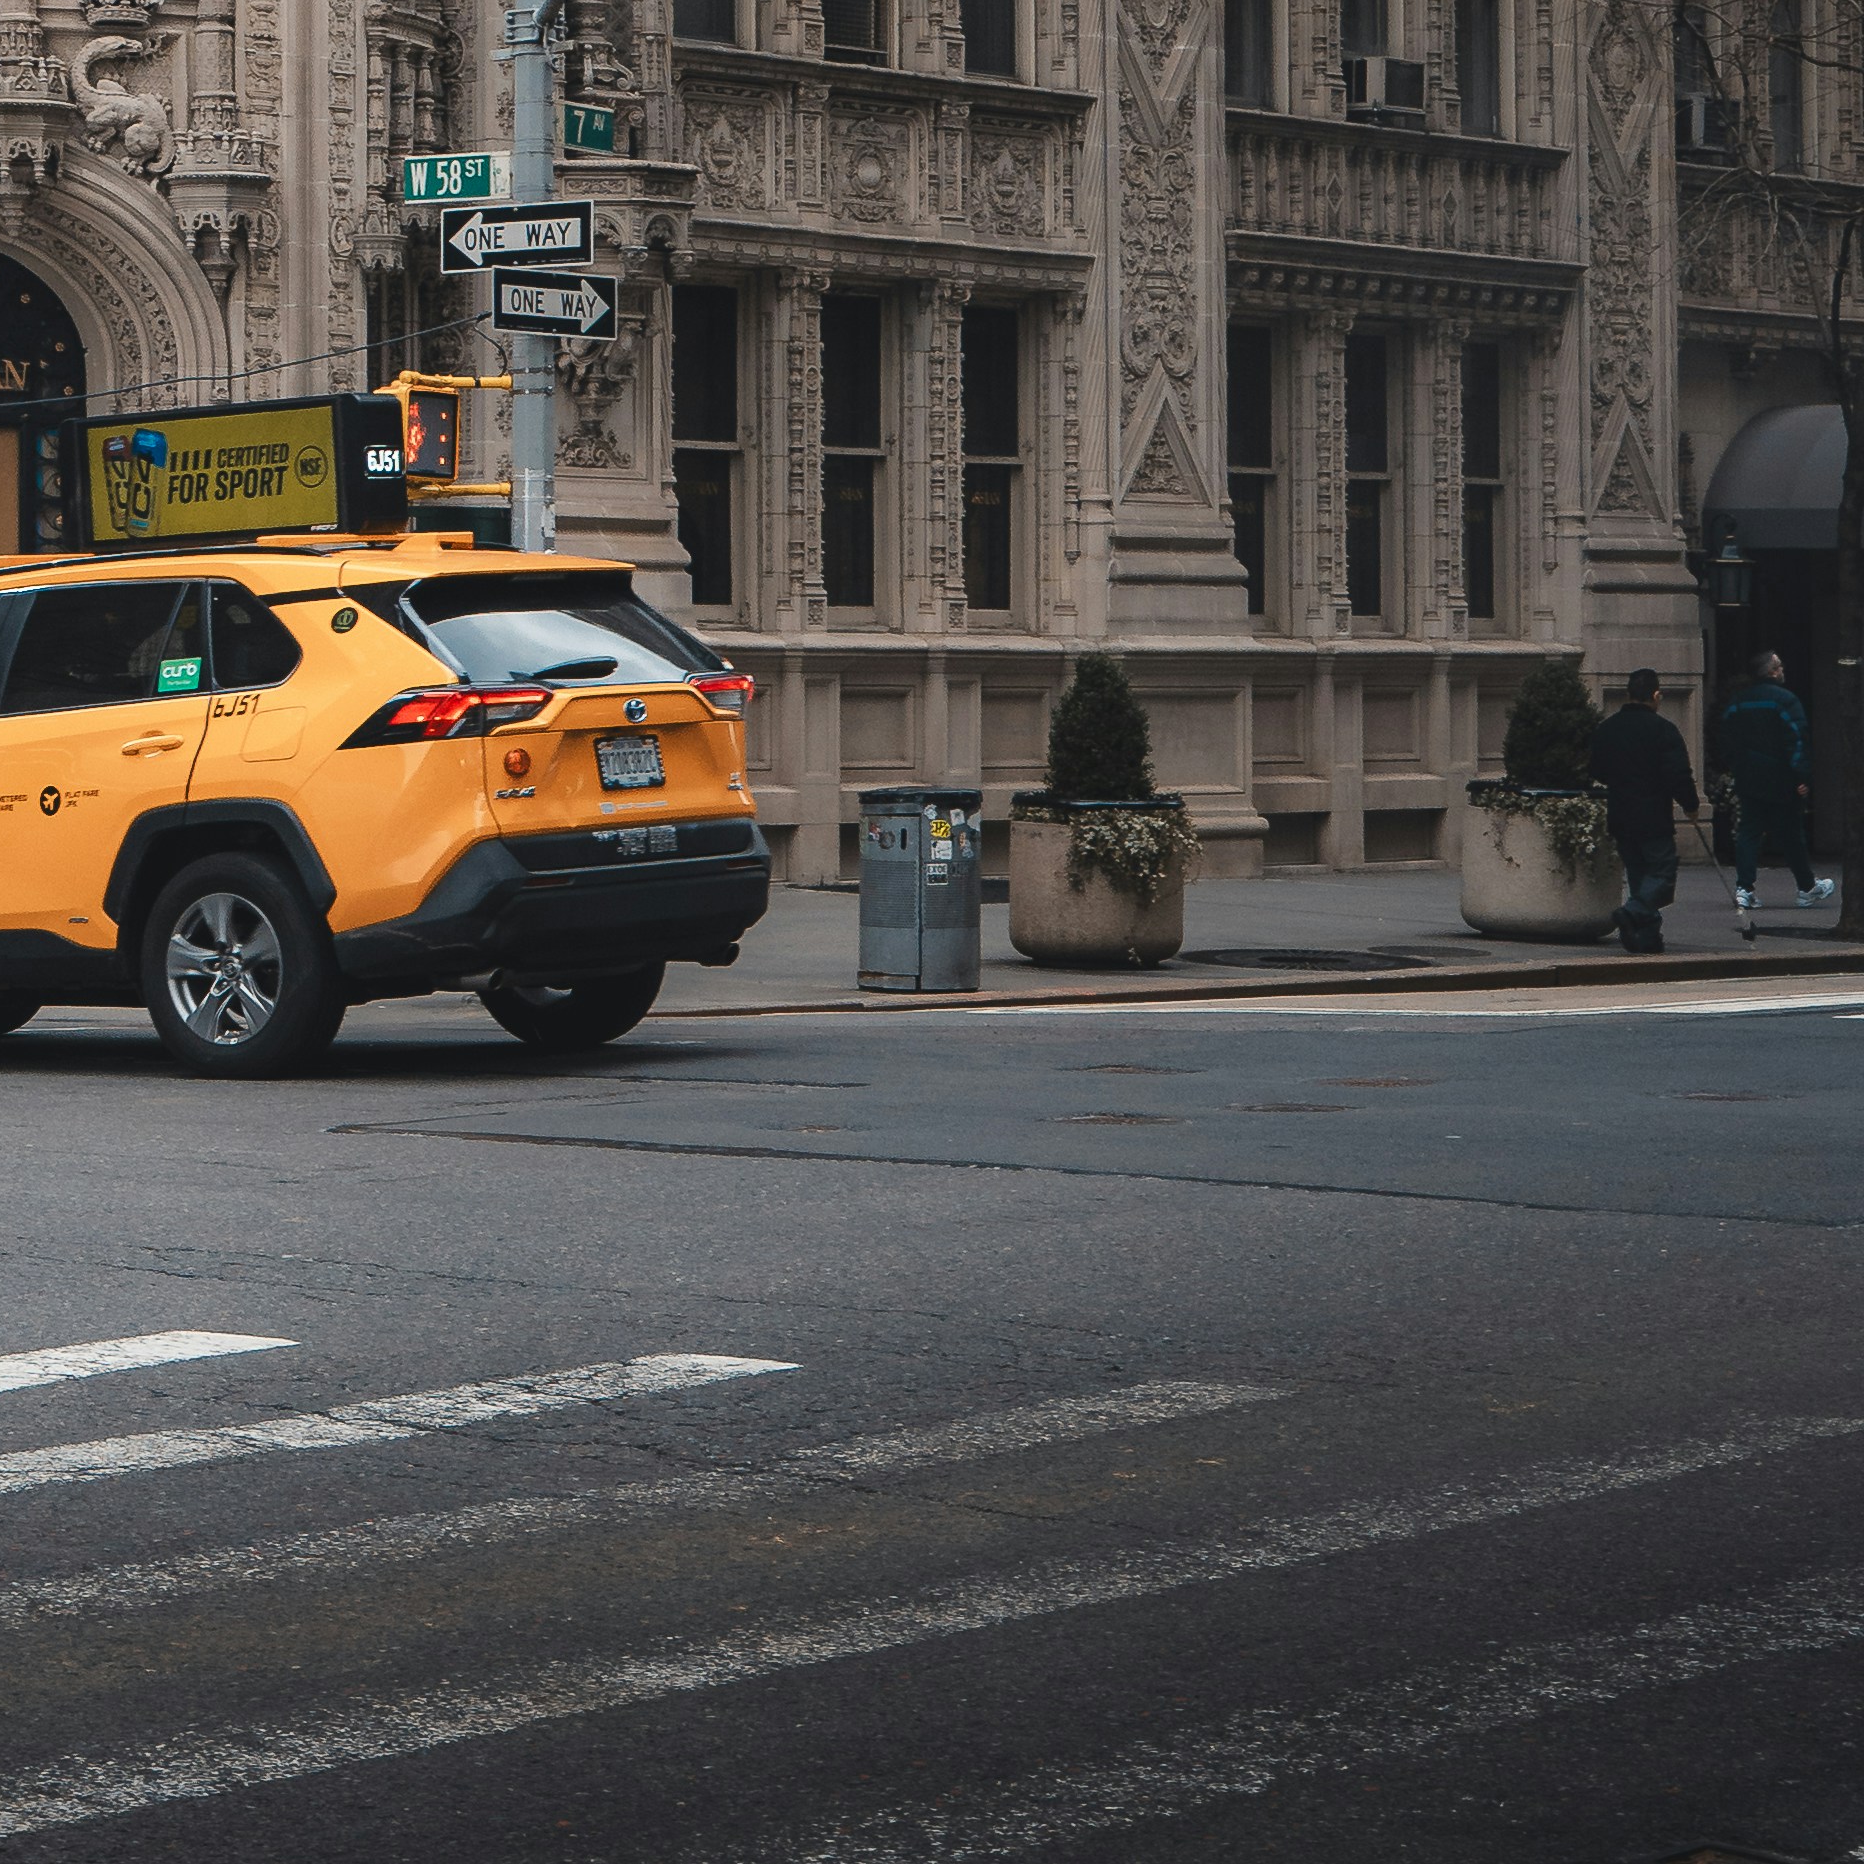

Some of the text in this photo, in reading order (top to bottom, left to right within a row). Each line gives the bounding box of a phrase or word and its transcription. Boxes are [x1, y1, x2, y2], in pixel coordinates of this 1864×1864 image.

[573, 109, 606, 144] 7 AV
[410, 161, 428, 197] W
[436, 159, 463, 197] 58
[464, 158, 485, 178] ST
[464, 221, 572, 251] ONE WAY
[510, 288, 598, 319] ONE WAY
[216, 442, 290, 470] CERTIFIED
[366, 449, 401, 473] 6J51
[167, 465, 290, 504] FOR SPORT
[162, 662, 198, 679] curb
[212, 694, 261, 719] 6J51
